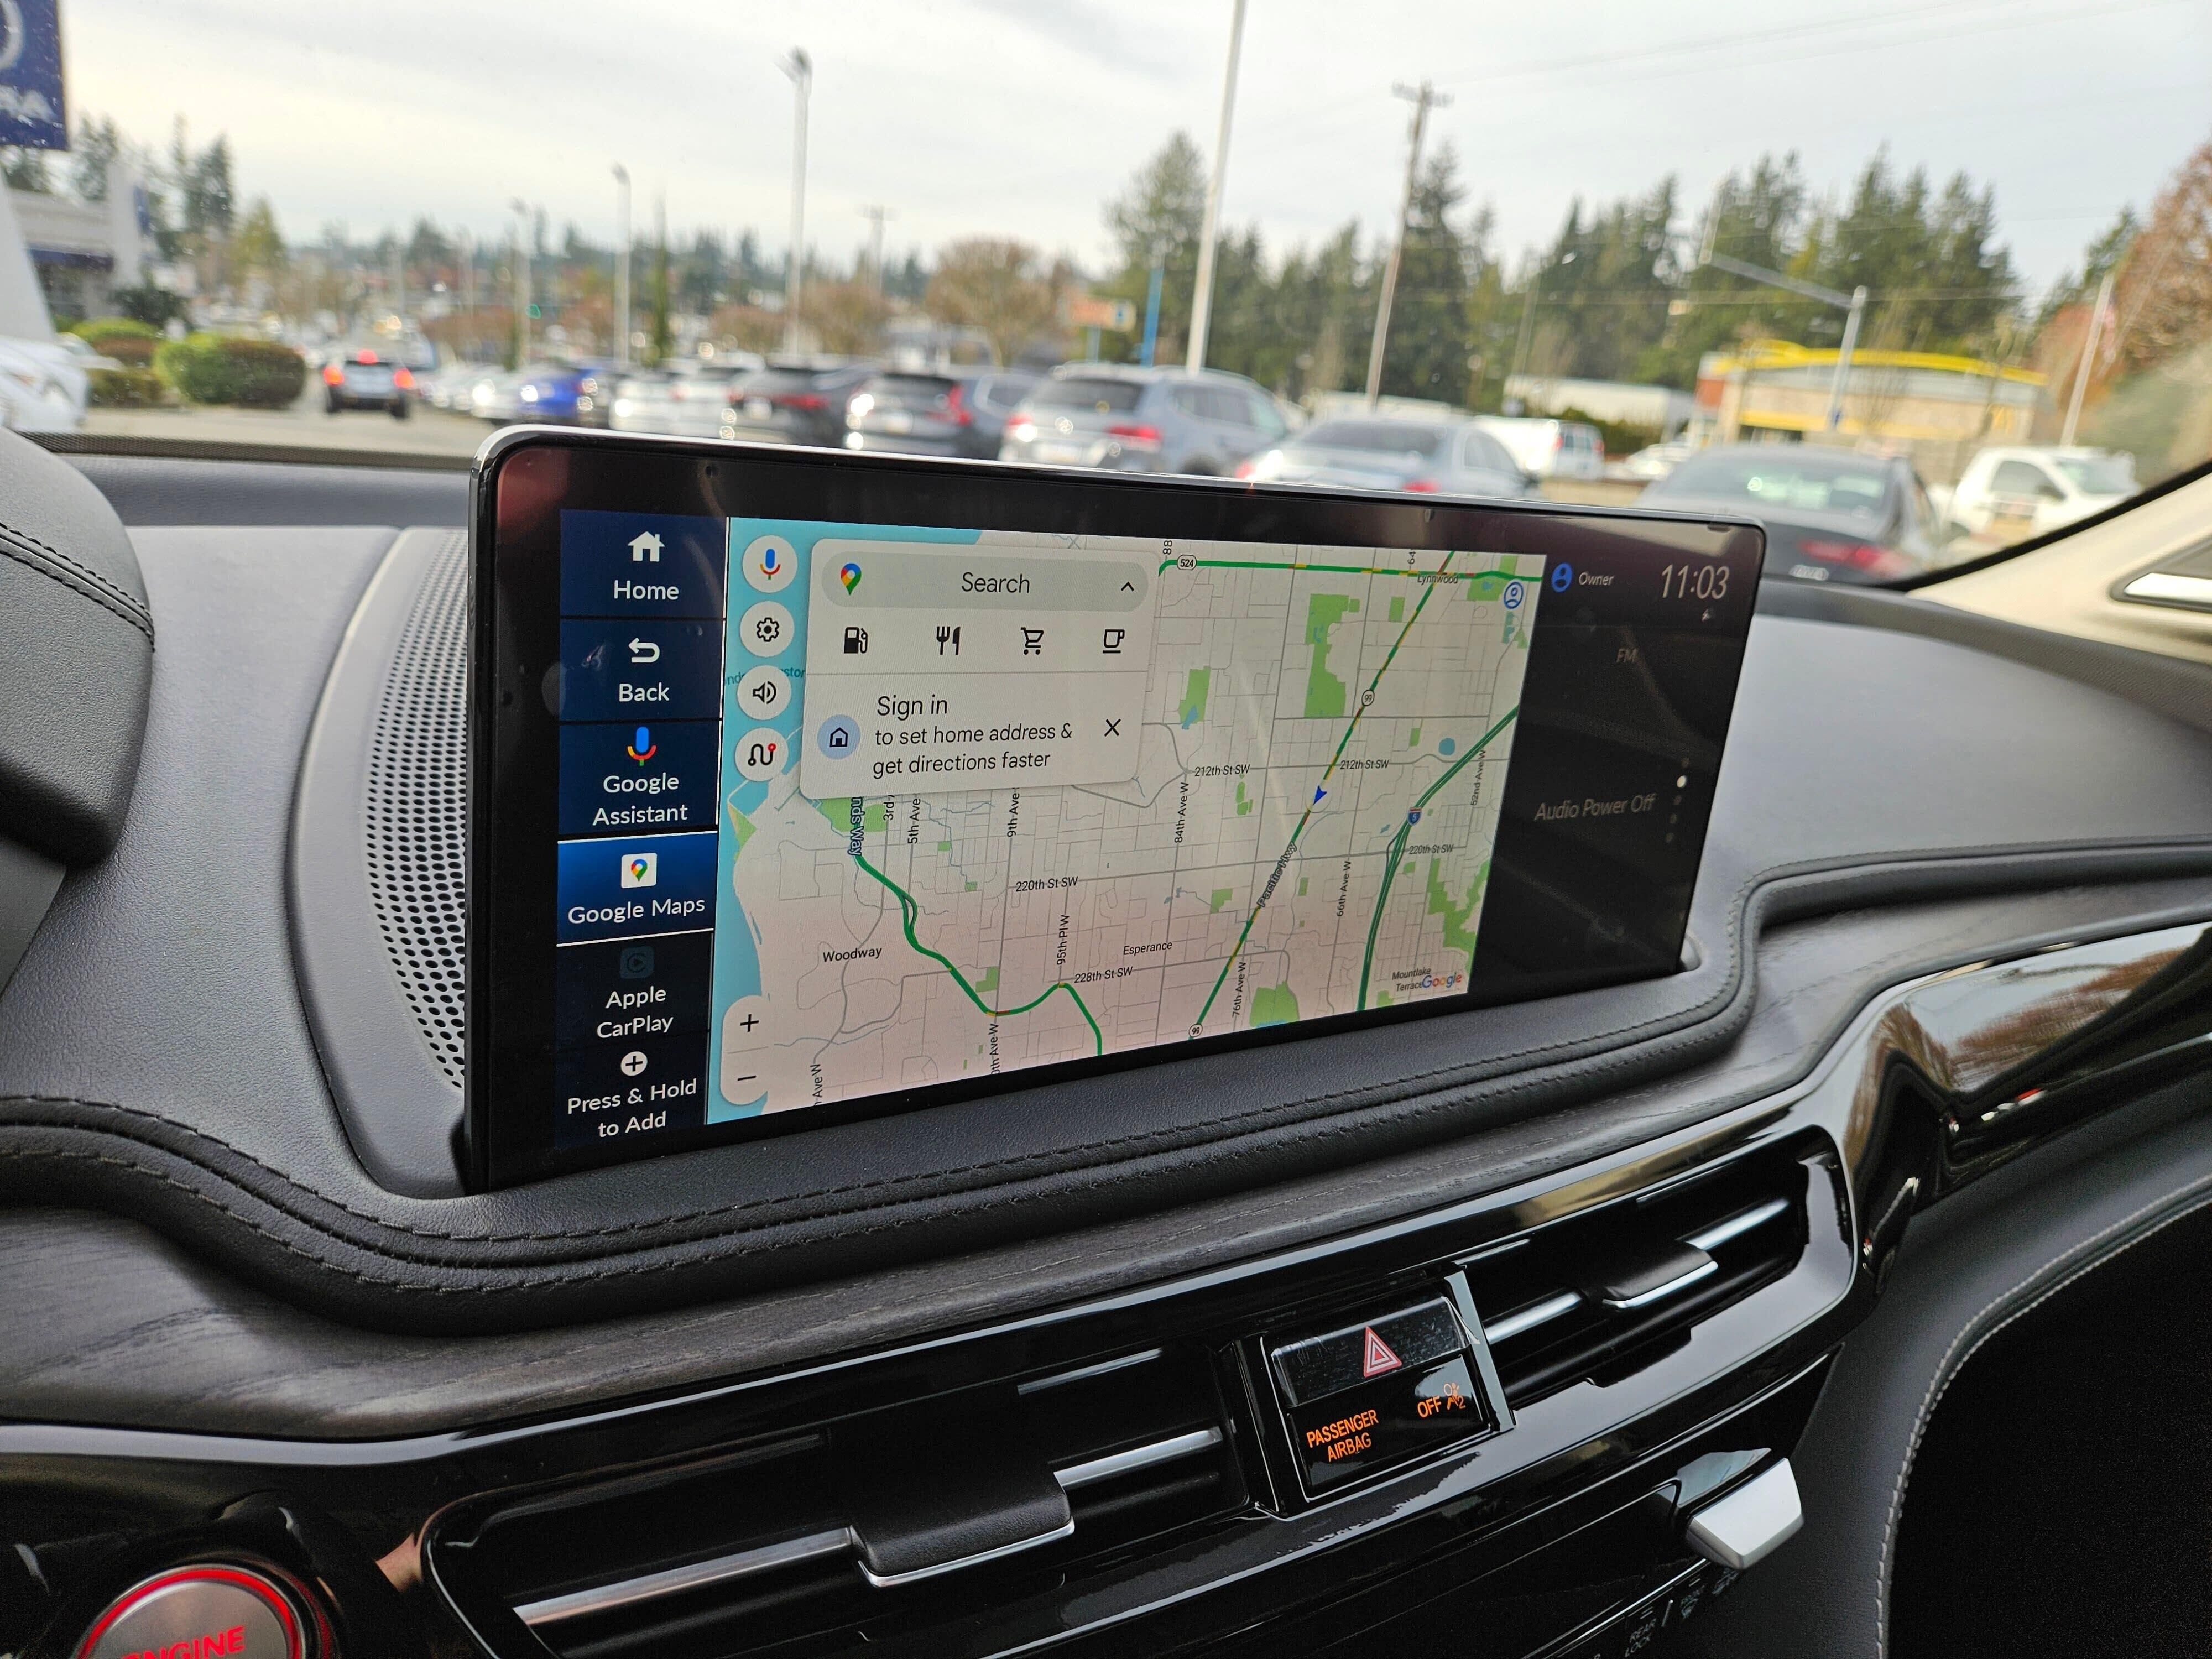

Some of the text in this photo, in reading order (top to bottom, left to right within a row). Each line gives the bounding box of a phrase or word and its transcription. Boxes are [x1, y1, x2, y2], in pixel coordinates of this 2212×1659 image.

[1180, 559, 1194, 568] 524
[614, 580, 680, 600] Home
[961, 571, 1031, 594] Search
[1417, 574, 1458, 586] Lynnwood
[1578, 571, 1614, 586] Owner
[1662, 564, 1730, 599] 11:03
[1616, 648, 1639, 664] FM
[619, 682, 670, 702] Back
[1364, 693, 1373, 702] 99
[877, 694, 948, 721] Sign in
[875, 722, 1073, 745] to set home address &
[873, 751, 1051, 779] get directions faster
[1194, 764, 1250, 777] 212th St SW
[1340, 759, 1390, 770] 212th St SW
[603, 772, 680, 795] Google
[1470, 749, 1486, 806] 52nd Ave W
[592, 804, 688, 826] Assistant
[883, 802, 895, 821] 3rd
[1007, 793, 1020, 837] 9th Ave
[1175, 782, 1190, 843] 84th Ave W
[1533, 792, 1658, 821] Audio Power Off
[907, 798, 921, 844] 5th Ave
[847, 826, 864, 855] Way
[1409, 844, 1454, 855] 220th St SW
[1015, 877, 1078, 892] 220th St SW
[1257, 842, 1297, 907] Pacific Hwy
[1336, 860, 1352, 917] 66th Ave W
[568, 898, 705, 924] Google Maps
[1061, 915, 1070, 925] W
[822, 947, 883, 963] Woodway
[1057, 940, 1067, 966] 95th
[1123, 942, 1172, 956] Esperance
[1074, 966, 1133, 983] 228th St SW
[1391, 967, 1431, 980] Mountlake
[1422, 972, 1462, 988] Google
[605, 986, 666, 1009] Apple
[1232, 962, 1246, 1018] 76th Ave W
[597, 1016, 674, 1039] CarPlay
[988, 1023, 999, 1035] W
[1191, 1026, 1201, 1035] 99
[989, 1036, 999, 1056] Ave
[810, 1063, 822, 1076] W
[567, 1078, 697, 1114] Press & Hold
[812, 1076, 823, 1098] Ave
[598, 1110, 666, 1138] to Add
[1417, 1395, 1442, 1418] OFF
[1306, 1409, 1379, 1448] PASSENGER
[1327, 1432, 1372, 1462] AIRBAG
[122, 1625, 246, 1659] GINE
